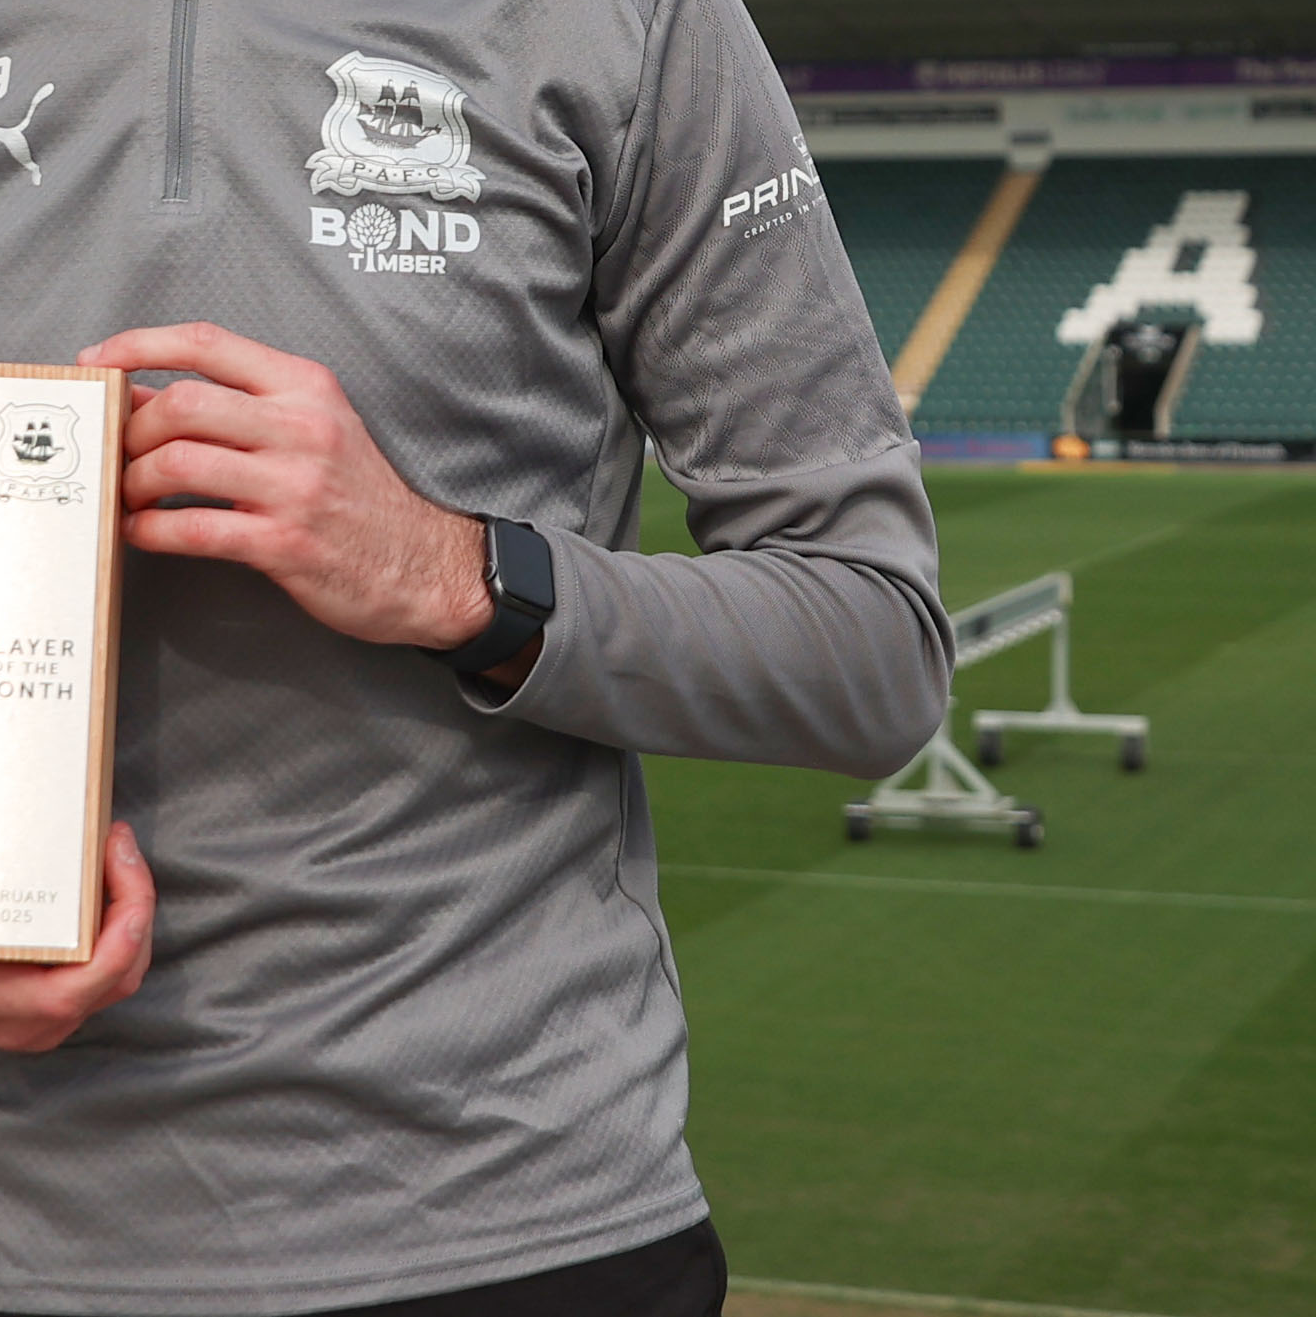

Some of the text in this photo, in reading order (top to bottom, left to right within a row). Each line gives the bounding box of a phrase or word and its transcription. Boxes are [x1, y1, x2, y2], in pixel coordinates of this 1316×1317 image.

[308, 202, 481, 253] BOND
[743, 211, 793, 239] CRAFTED
[347, 248, 447, 274] TIMBER
[23, 661, 59, 675] THE
